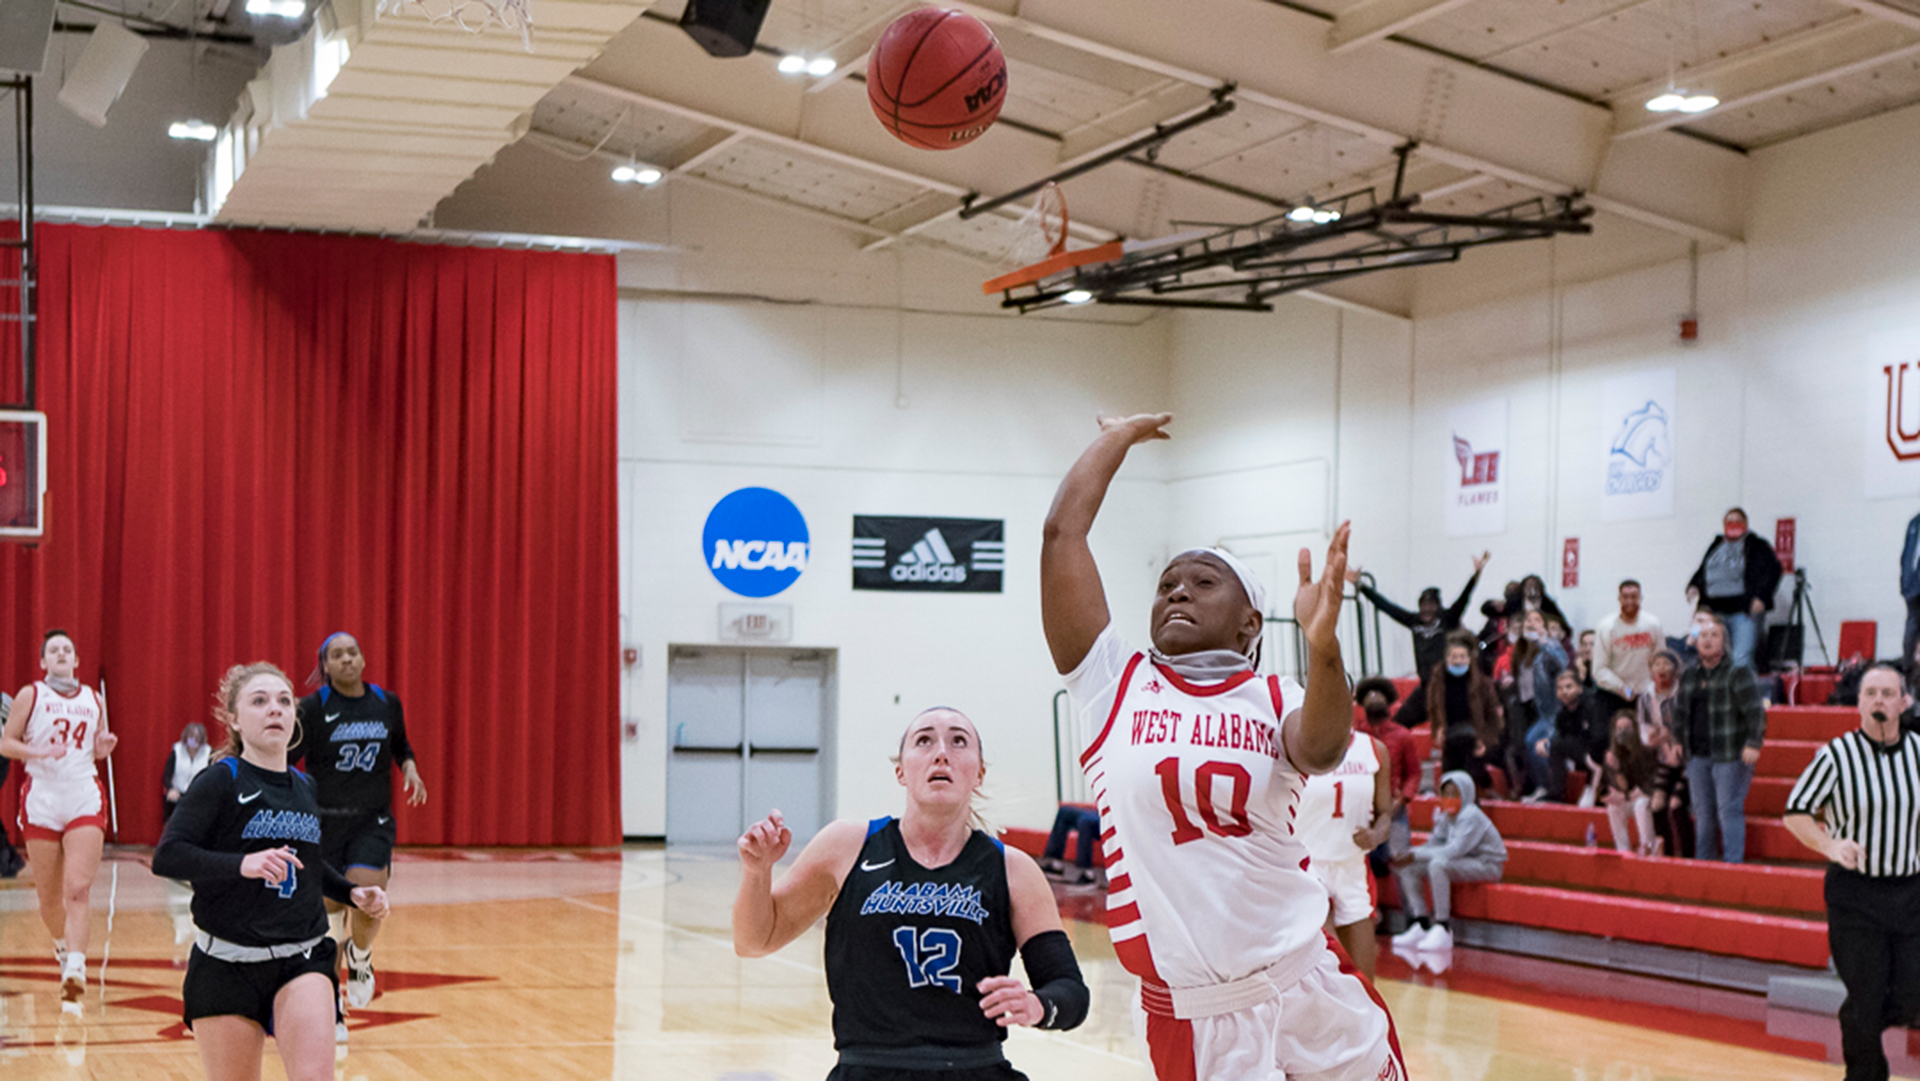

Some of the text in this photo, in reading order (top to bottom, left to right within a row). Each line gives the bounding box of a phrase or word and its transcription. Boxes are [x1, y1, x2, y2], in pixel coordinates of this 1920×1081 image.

[712, 539, 809, 572] NCAA
[891, 563, 967, 583] adidas
[50, 717, 88, 750] 34
[1131, 709, 1182, 746] WEST
[335, 742, 381, 772] 34
[1155, 756, 1254, 847] 10
[1332, 781, 1344, 818] 1
[248, 808, 320, 826] ALABAMA
[870, 879, 982, 905] ALABAMA
[860, 895, 990, 926] HUNTSVILLE
[892, 925, 963, 994] 12
